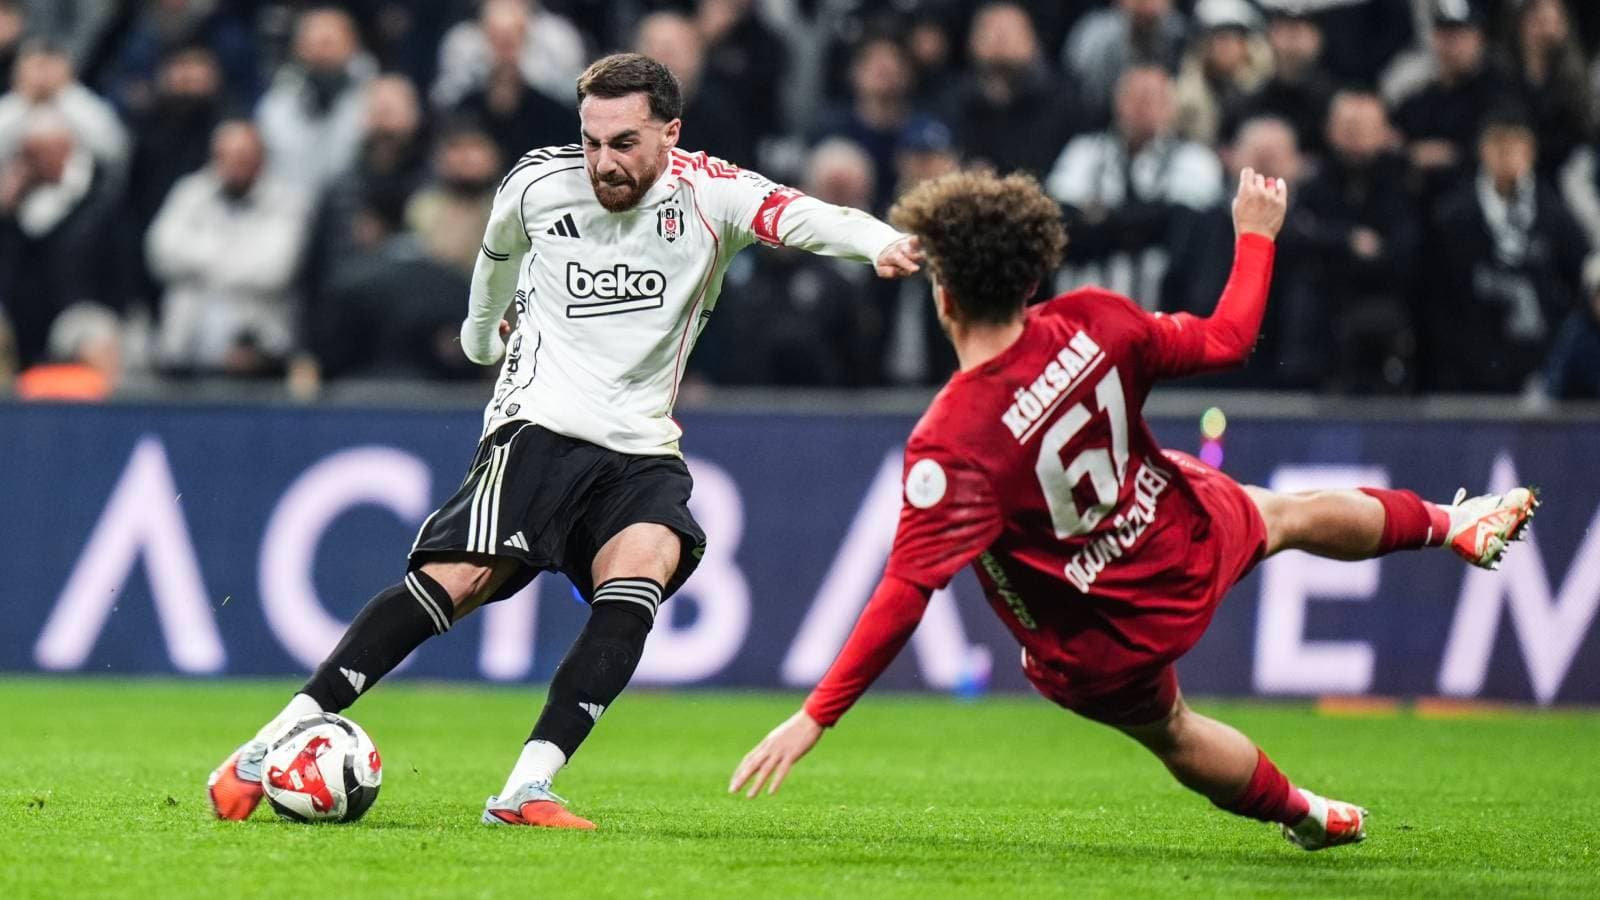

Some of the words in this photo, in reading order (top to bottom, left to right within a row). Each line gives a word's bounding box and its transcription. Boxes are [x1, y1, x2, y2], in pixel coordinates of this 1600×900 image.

[567, 262, 666, 298] beko
[1001, 329, 1100, 439] KÖKSAN
[1035, 365, 1129, 540] 61
[34, 433, 1600, 704] ACBAEM
